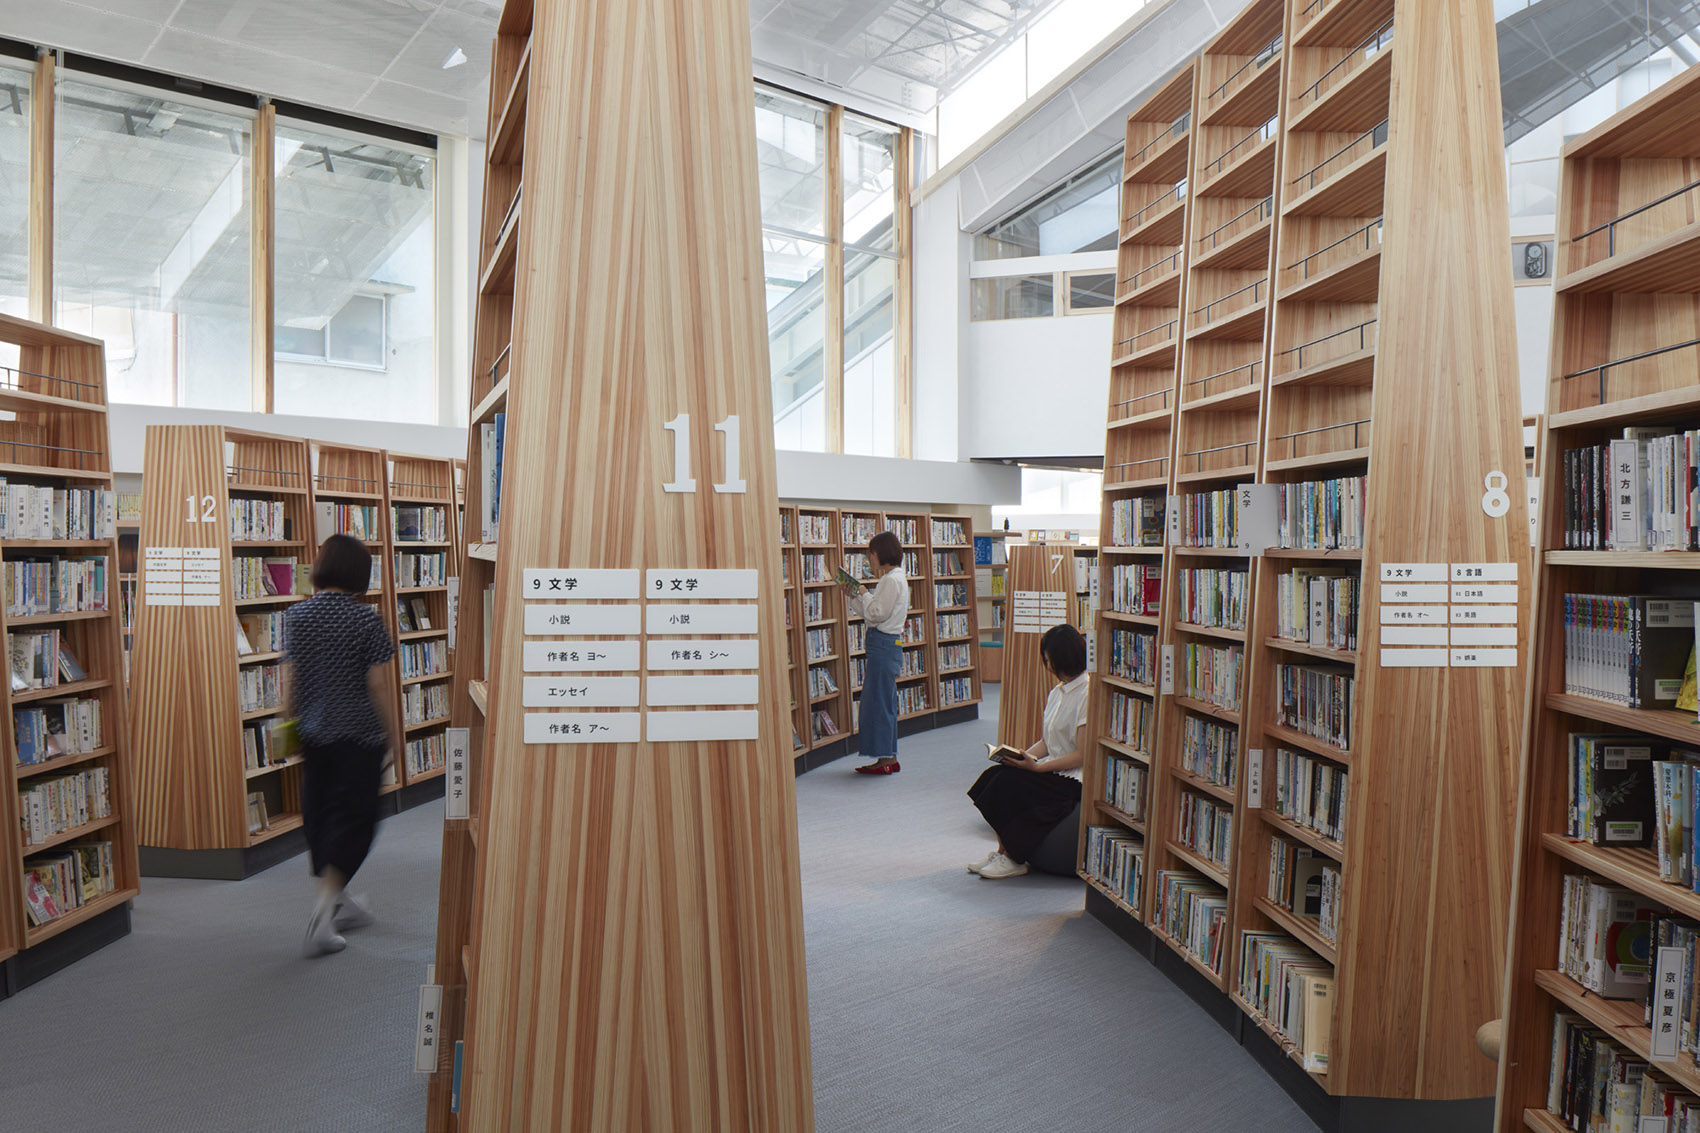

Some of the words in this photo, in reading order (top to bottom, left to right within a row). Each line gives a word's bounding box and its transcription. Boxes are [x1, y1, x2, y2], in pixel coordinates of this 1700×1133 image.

[663, 413, 747, 494] 11
[1481, 470, 1511, 518] 8
[1620, 463, 1632, 521] 北方謙三
[1242, 489, 1251, 508] 文学
[185, 495, 217, 523] 12
[1244, 542, 1250, 550] 9
[1050, 554, 1064, 575] 7
[1386, 569, 1392, 577] 9
[1395, 568, 1413, 578] 文学
[1456, 568, 1462, 577] 8
[1465, 568, 1482, 577] 言語
[533, 579, 541, 590] 9
[549, 578, 578, 591] 文学
[655, 579, 663, 590] 9
[670, 578, 698, 591] 文学
[1395, 590, 1408, 598] 小説
[549, 614, 571, 625] 小説
[669, 614, 690, 625] 小説
[1393, 611, 1413, 619] 作者名
[547, 651, 580, 662] 作者名
[671, 650, 703, 661] 作者名
[548, 687, 589, 697] エッセイ
[549, 723, 581, 734] 作者名
[453, 748, 463, 799] 佐藤愛子
[1661, 972, 1676, 1033] 京極夏彦
[423, 1010, 434, 1046] 椎名誠
